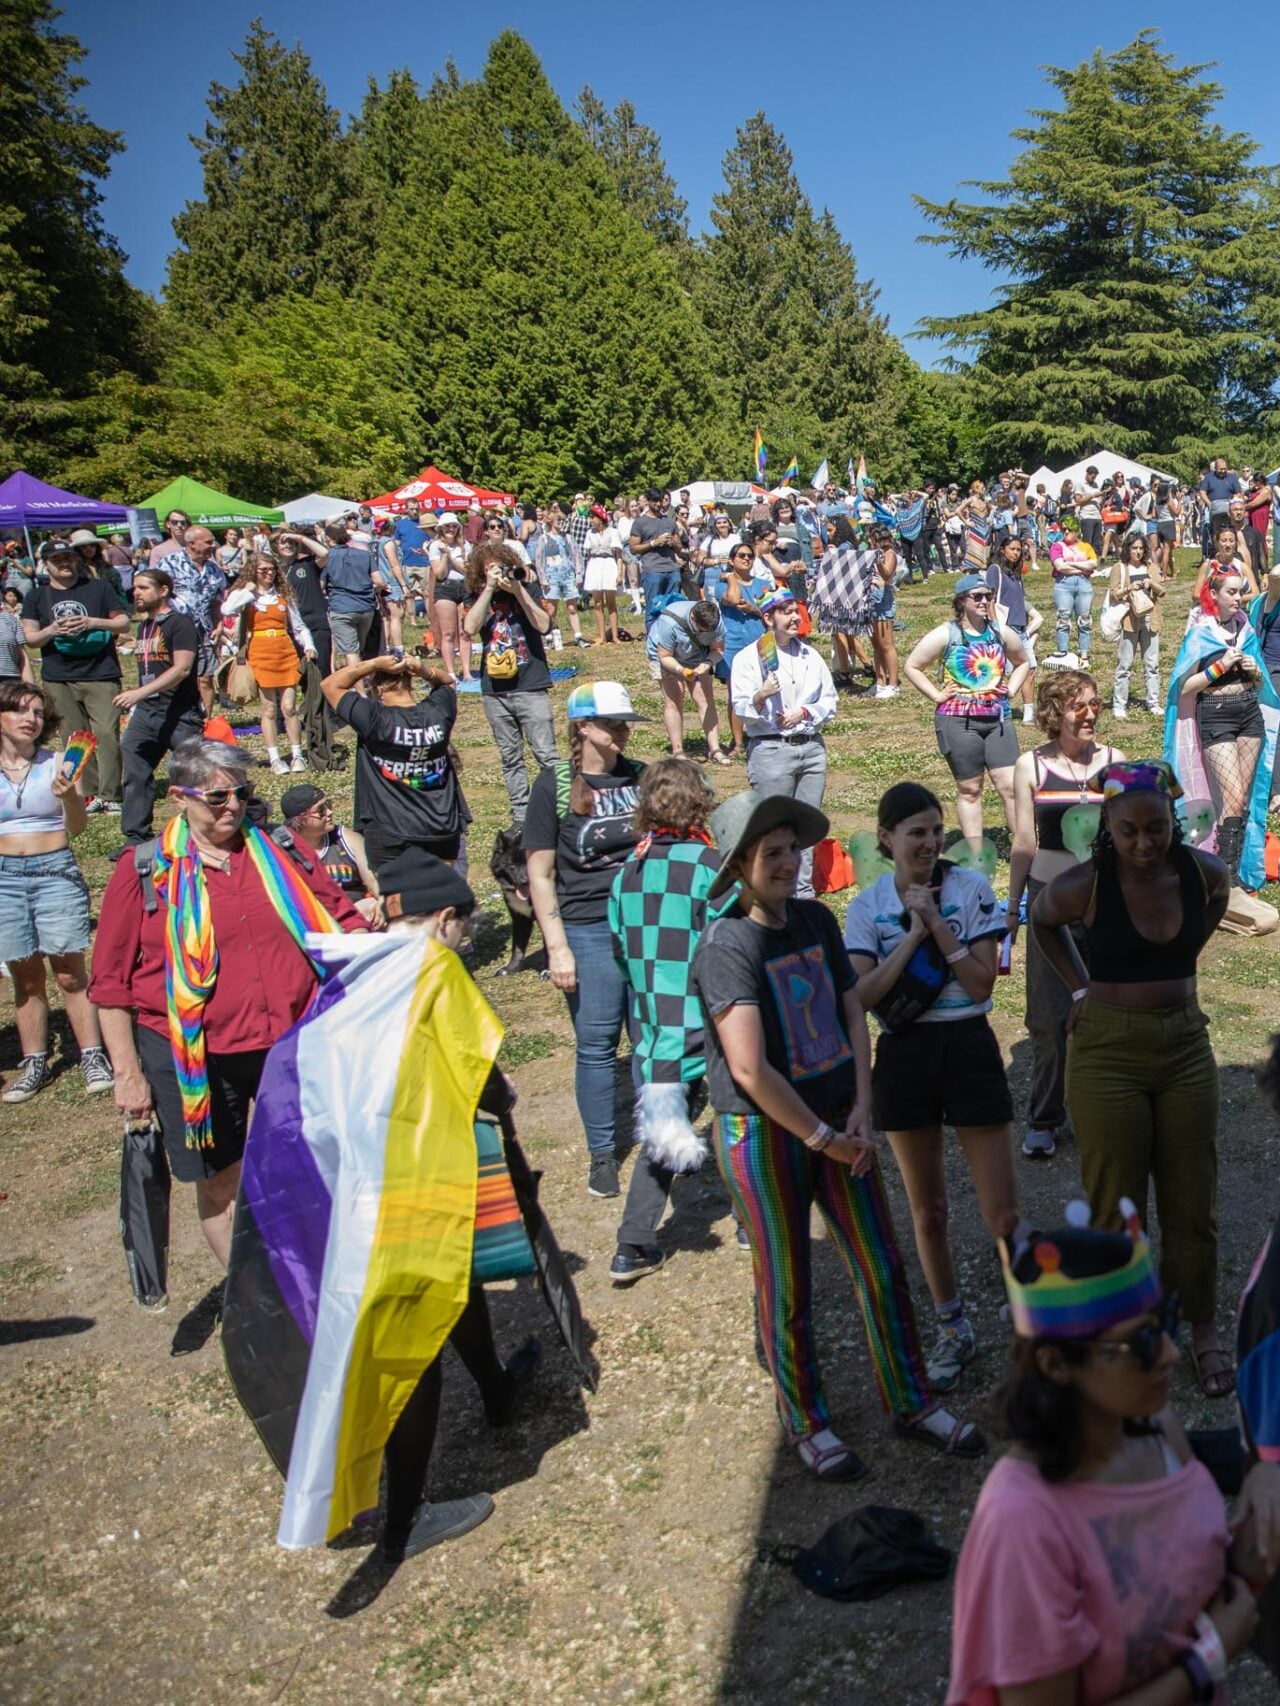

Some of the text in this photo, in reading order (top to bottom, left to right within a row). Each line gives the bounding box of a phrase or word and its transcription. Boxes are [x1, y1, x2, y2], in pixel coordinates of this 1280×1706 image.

[393, 724, 444, 746] LET ME
[410, 746, 431, 761] BE
